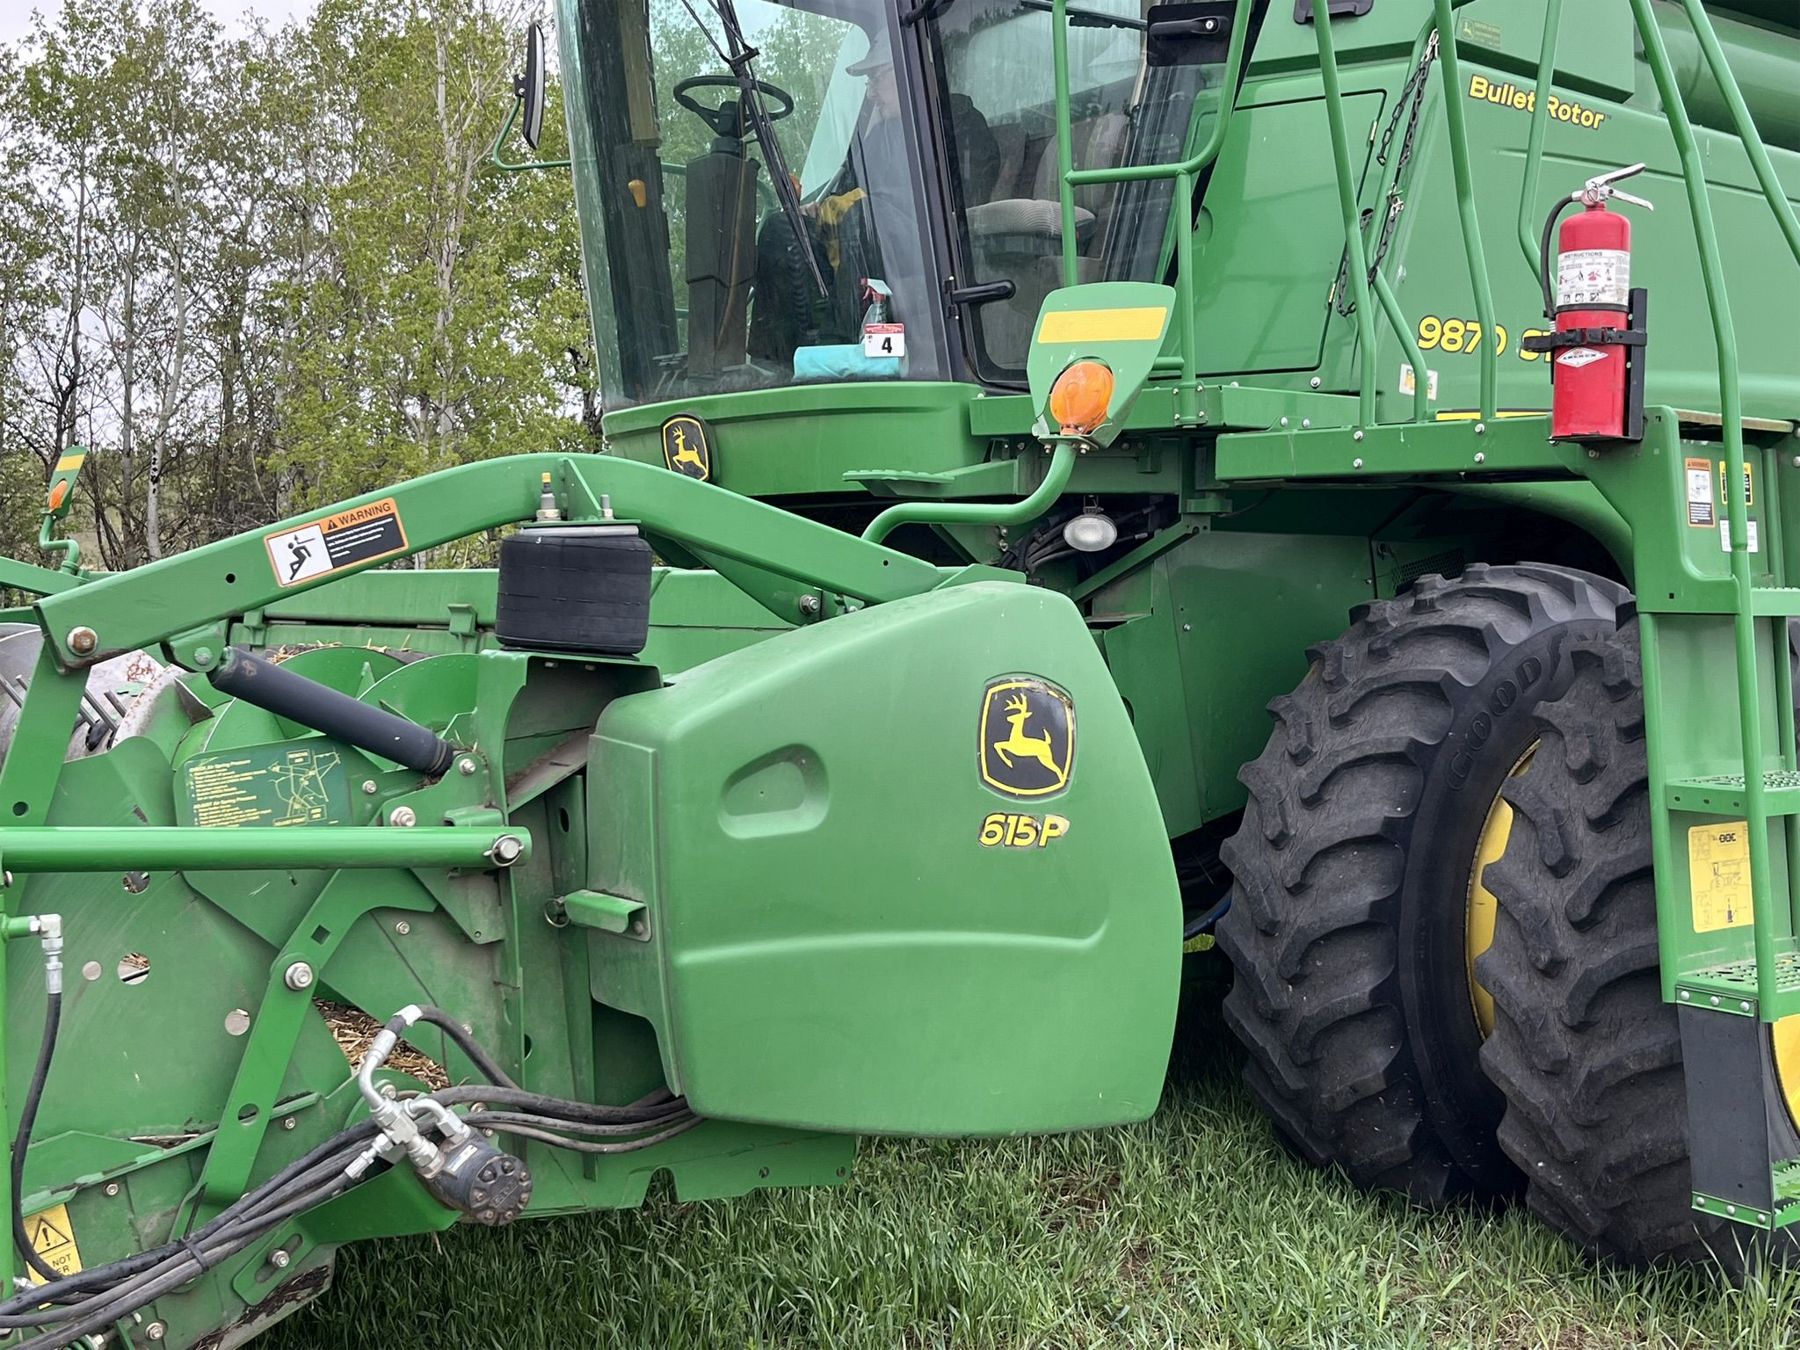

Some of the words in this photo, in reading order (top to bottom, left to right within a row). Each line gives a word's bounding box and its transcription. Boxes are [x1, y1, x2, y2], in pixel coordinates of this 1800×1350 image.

[1468, 74, 1535, 113] Bullet
[881, 337, 893, 354] 4
[338, 502, 391, 525] WARNING
[978, 812, 1070, 848] 615P
[52, 1253, 71, 1267] NOT
